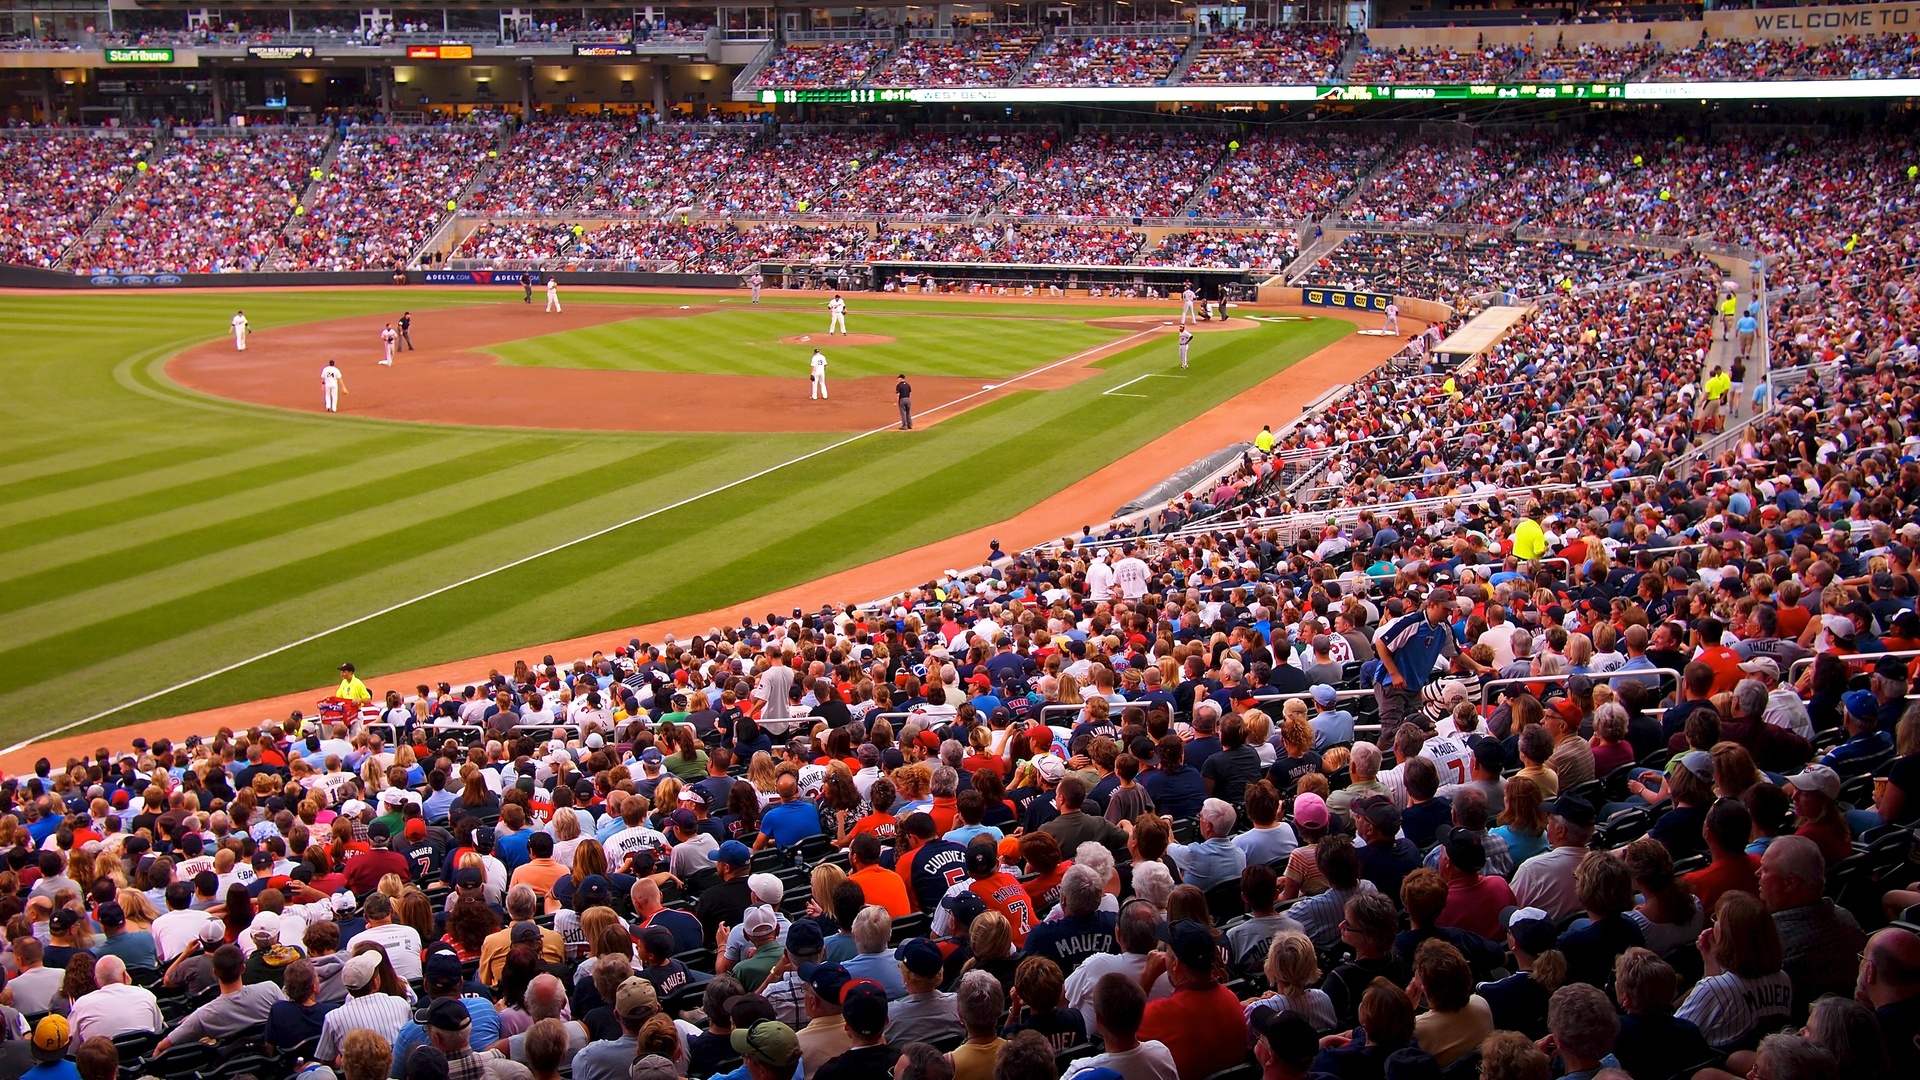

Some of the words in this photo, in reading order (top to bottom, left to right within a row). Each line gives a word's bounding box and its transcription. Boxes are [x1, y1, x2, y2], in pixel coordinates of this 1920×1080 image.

[1755, 11, 1872, 30] WELCOME
[1879, 9, 1908, 25] TO
[109, 50, 169, 61] StarTribune
[923, 91, 958, 99] WEST
[961, 91, 997, 99] BEND
[1378, 86, 1390, 96] 14
[1577, 88, 1585, 97] 7
[1748, 641, 1778, 652] THOME
[1431, 741, 1459, 757] MAUER
[1447, 758, 1465, 784] 7
[325, 776, 346, 787] KUBEL
[875, 823, 897, 837] THOM
[410, 846, 433, 859] MAUER
[186, 861, 212, 876] RAUCH
[418, 857, 431, 873] 7
[992, 884, 1023, 904] MAUER
[1043, 883, 1062, 902] MOR
[1007, 900, 1030, 934] 7
[564, 928, 586, 943] CUD
[1055, 933, 1112, 958] MAUER
[1250, 937, 1272, 960] MOR
[661, 971, 687, 994] MAUER
[1743, 984, 1790, 1013] MAUER
[46, 1038, 55, 1048] P
